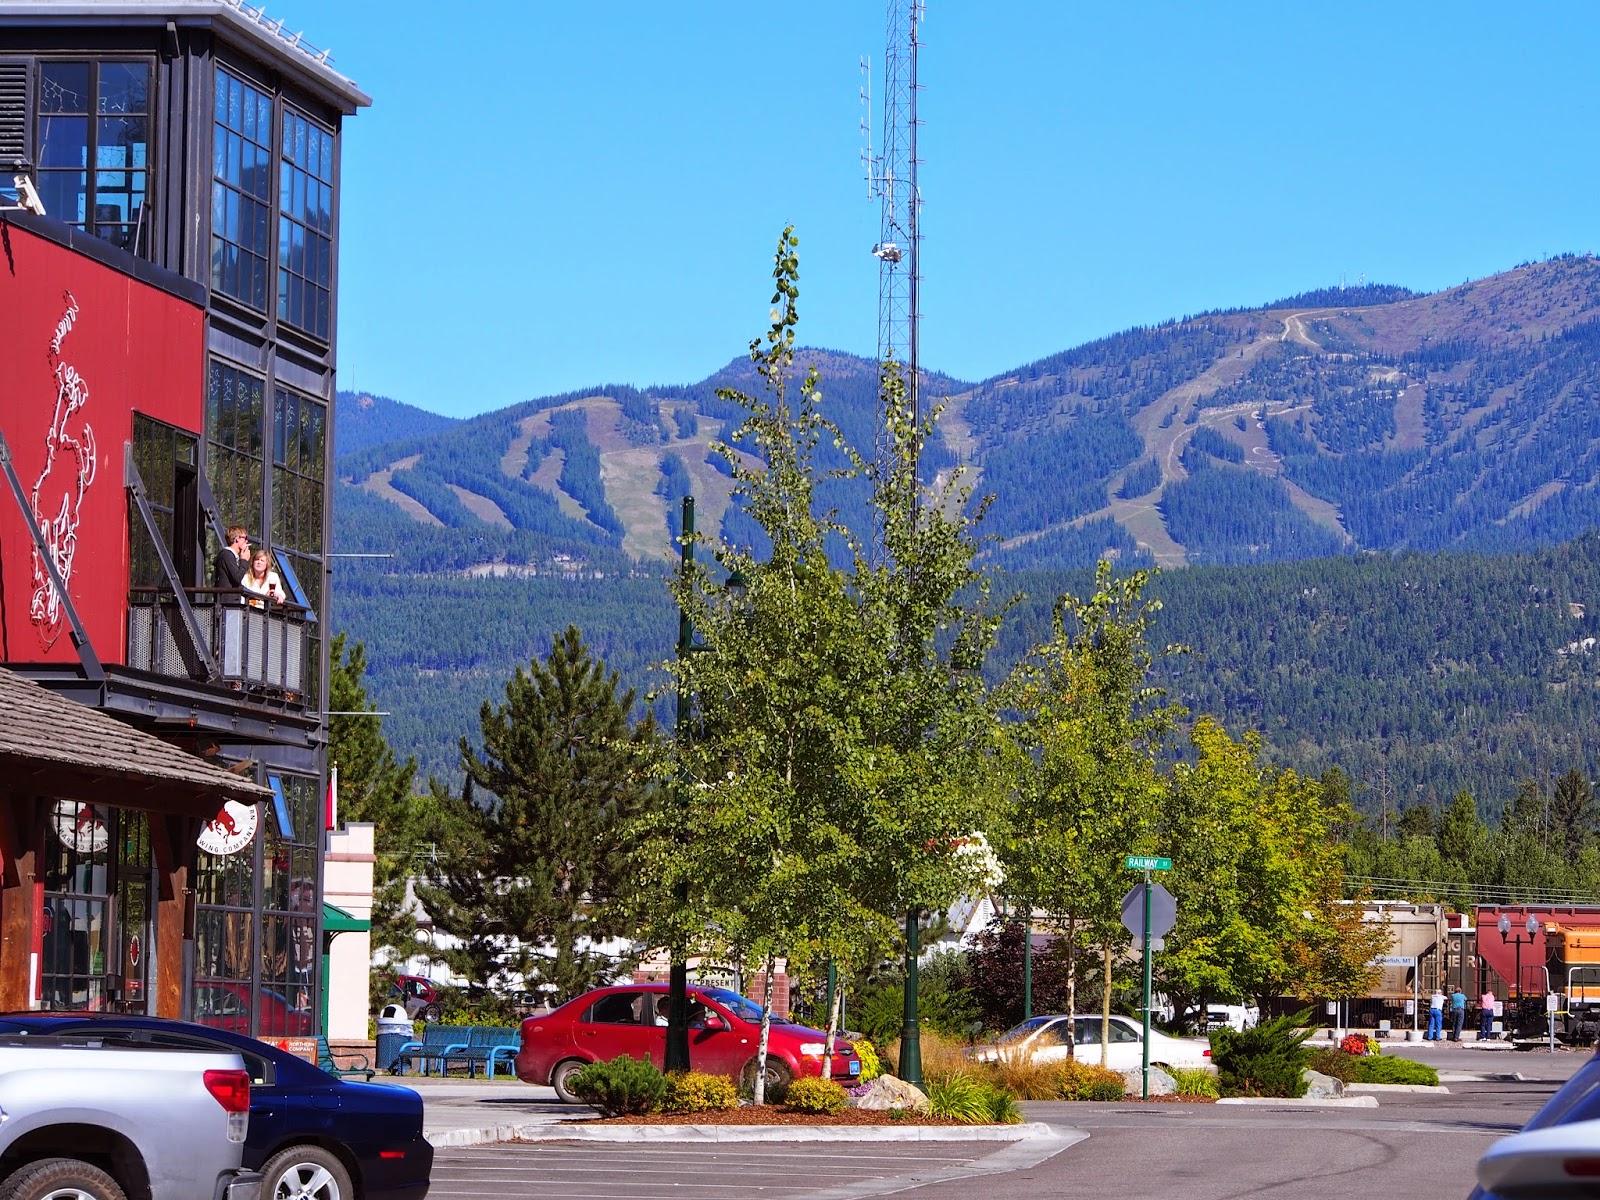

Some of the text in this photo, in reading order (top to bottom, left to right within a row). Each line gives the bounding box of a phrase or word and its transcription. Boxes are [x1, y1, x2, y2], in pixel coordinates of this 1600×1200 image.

[199, 826, 254, 853] WING COMPANY
[1128, 858, 1159, 868] RAILWAY
[701, 979, 739, 988] PRESENT
